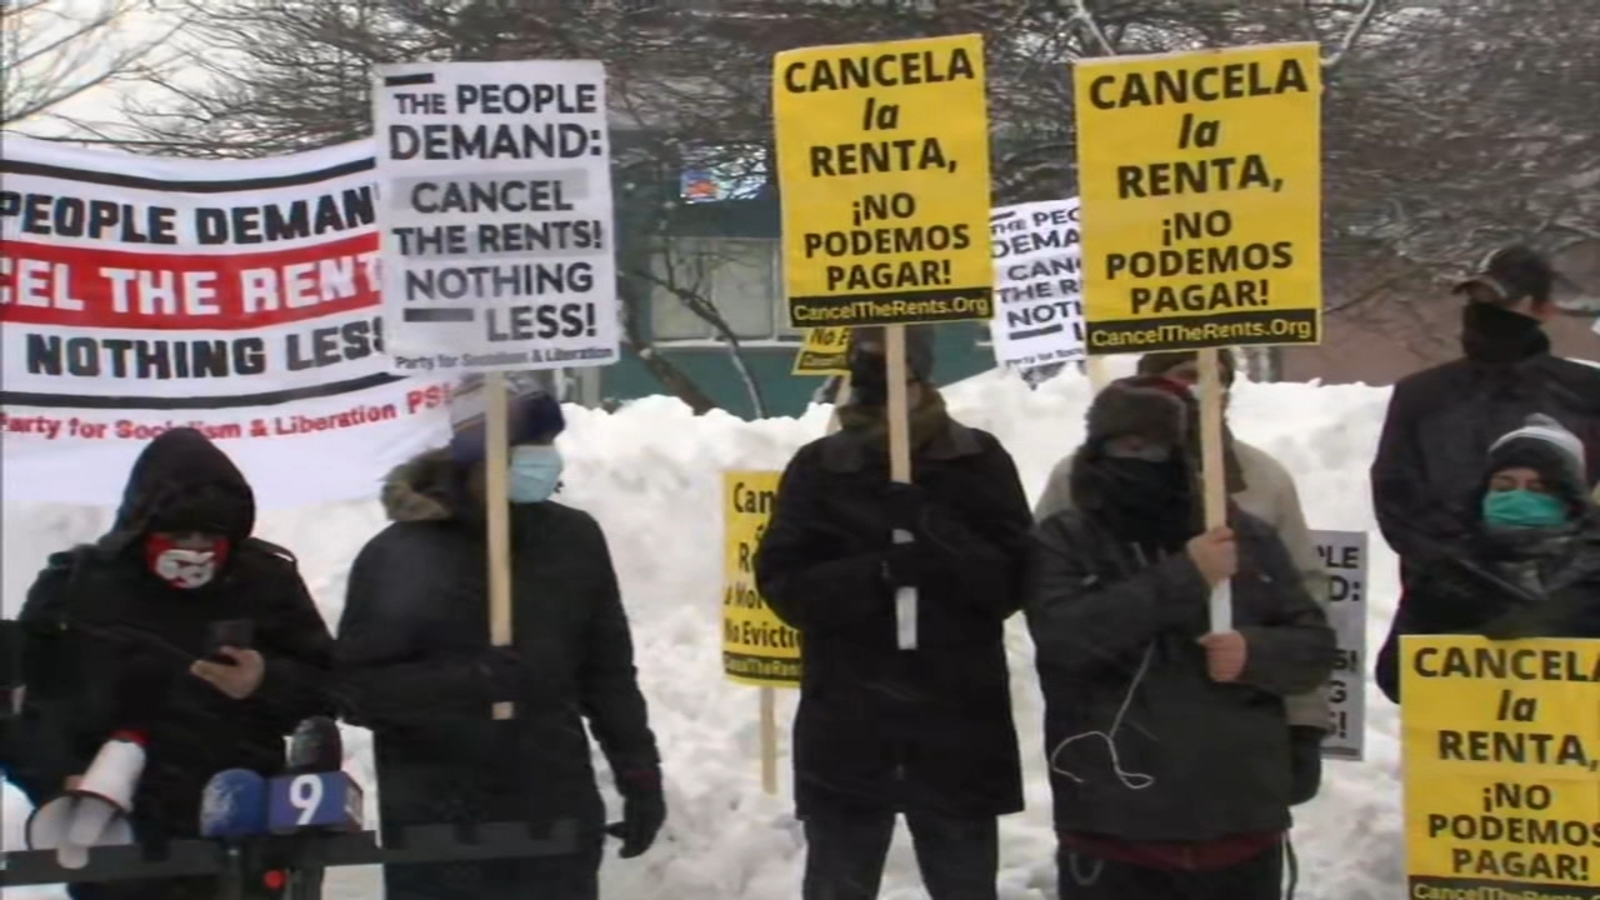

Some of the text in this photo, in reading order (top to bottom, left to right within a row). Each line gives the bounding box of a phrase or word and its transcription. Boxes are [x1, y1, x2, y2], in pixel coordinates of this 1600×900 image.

[784, 48, 975, 94] CANCELA
[1089, 58, 1308, 110] CANCELA
[394, 83, 597, 115] THE PEOPLE
[863, 97, 900, 131] la
[389, 122, 602, 160] DEMAND:
[1178, 113, 1220, 149] la
[809, 137, 957, 177] RENTA,
[1117, 154, 1283, 199] RENTA,
[0, 183, 380, 245] PEOPLE DEMAN
[411, 180, 573, 213] CANCEL
[853, 192, 916, 226] ¡NO
[392, 219, 602, 256] THE RENTS!
[804, 224, 971, 259] PODEMOS
[1163, 210, 1232, 246] ¡NO
[827, 259, 951, 291] PAGAR!
[1007, 257, 1081, 281] CAN
[1106, 241, 1293, 280] PODEMOS
[99, 266, 220, 316] THE
[405, 263, 593, 301] NOTHING
[998, 282, 1053, 303] THE
[1130, 279, 1268, 314] PAGAR!
[486, 303, 596, 342] LESS!
[794, 296, 990, 322] CancelTheRents.Org
[1091, 318, 1311, 346] CancelTheRents.Org
[26, 333, 266, 379] NOTHING
[68, 417, 107, 439] for
[275, 404, 396, 435] Liberation
[1414, 646, 1600, 683] CANCEL
[1497, 689, 1538, 722] la
[1438, 730, 1599, 772] RENTA,
[289, 773, 323, 825] 9
[1483, 782, 1551, 812] ¡NO
[1452, 848, 1589, 881] PAGAR!
